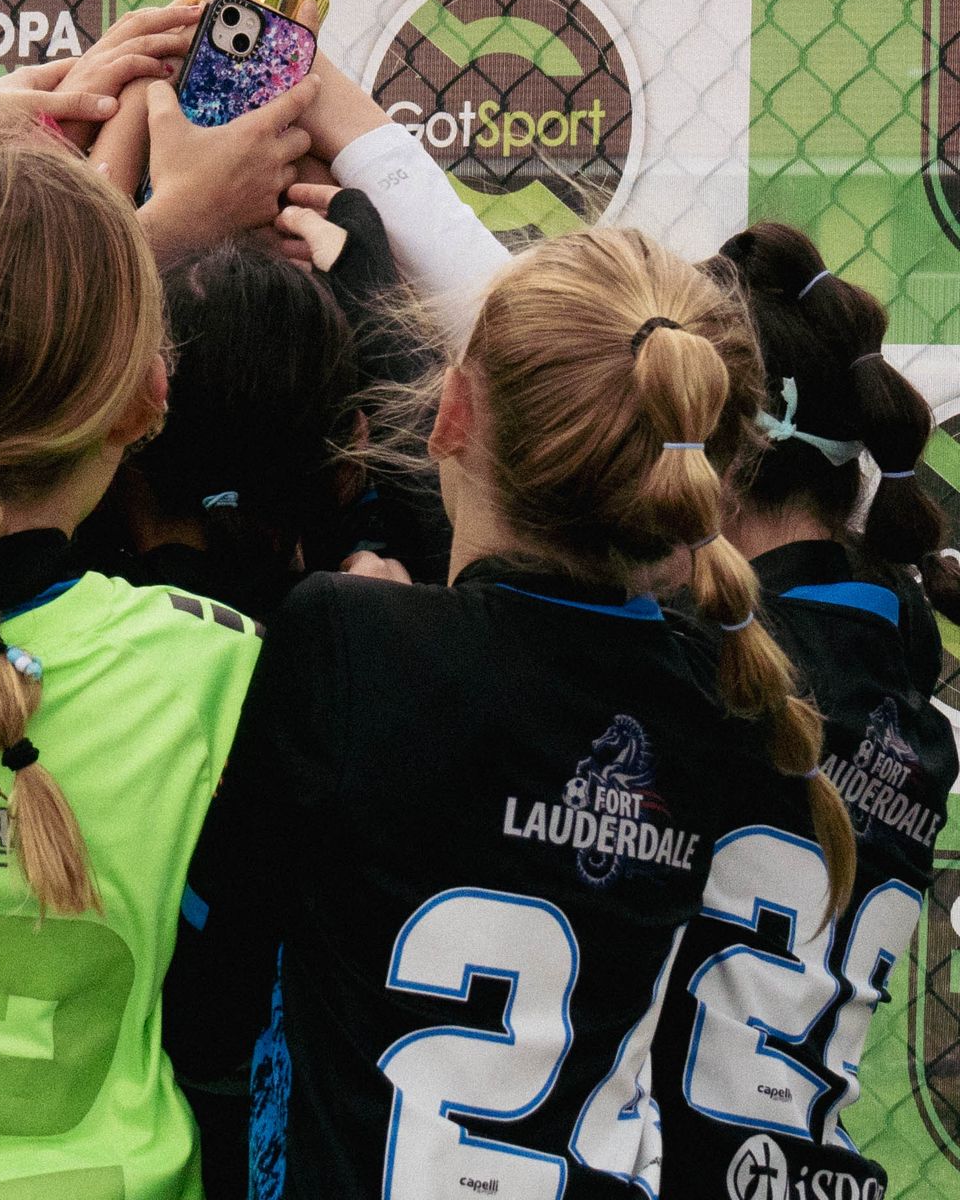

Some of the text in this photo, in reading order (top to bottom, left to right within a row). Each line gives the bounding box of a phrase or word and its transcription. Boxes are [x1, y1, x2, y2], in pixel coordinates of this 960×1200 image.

[385, 98, 606, 157] GotSport
[871, 751, 911, 789] FORT
[594, 785, 644, 820] FORT
[820, 753, 941, 847] AUDERDALE
[503, 796, 700, 870] LAUDERDALE
